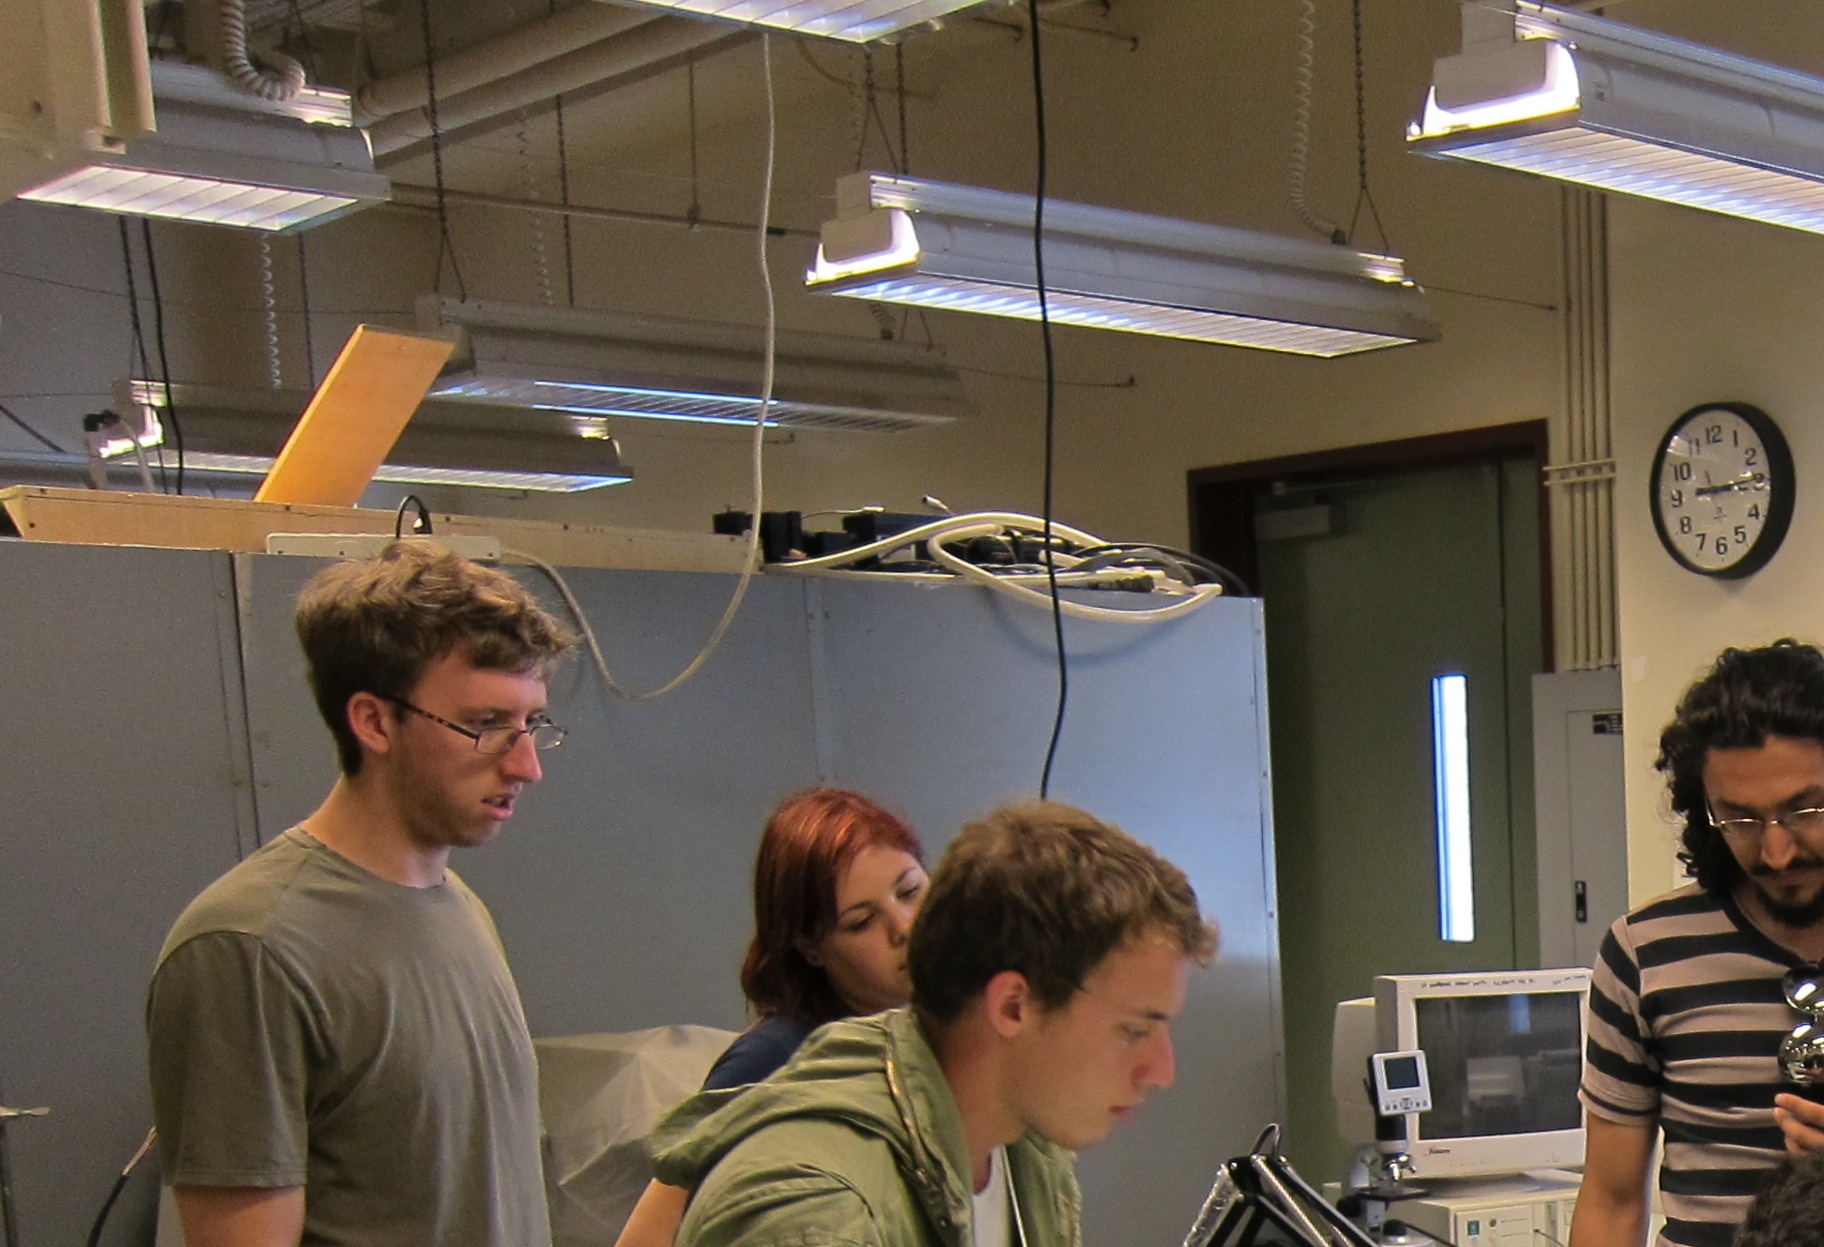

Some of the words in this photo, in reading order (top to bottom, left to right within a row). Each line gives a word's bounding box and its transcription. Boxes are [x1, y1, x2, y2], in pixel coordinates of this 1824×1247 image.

[1705, 425, 1722, 444] 12
[1689, 438, 1700, 456] 11
[1745, 448, 1757, 465] 2
[1674, 462, 1691, 481] 10
[1671, 490, 1683, 508] 9
[1748, 503, 1760, 520] 4
[1680, 516, 1692, 534] 8
[1696, 533, 1706, 551] 7
[1734, 525, 1747, 544] 5
[1715, 537, 1728, 555] 6
